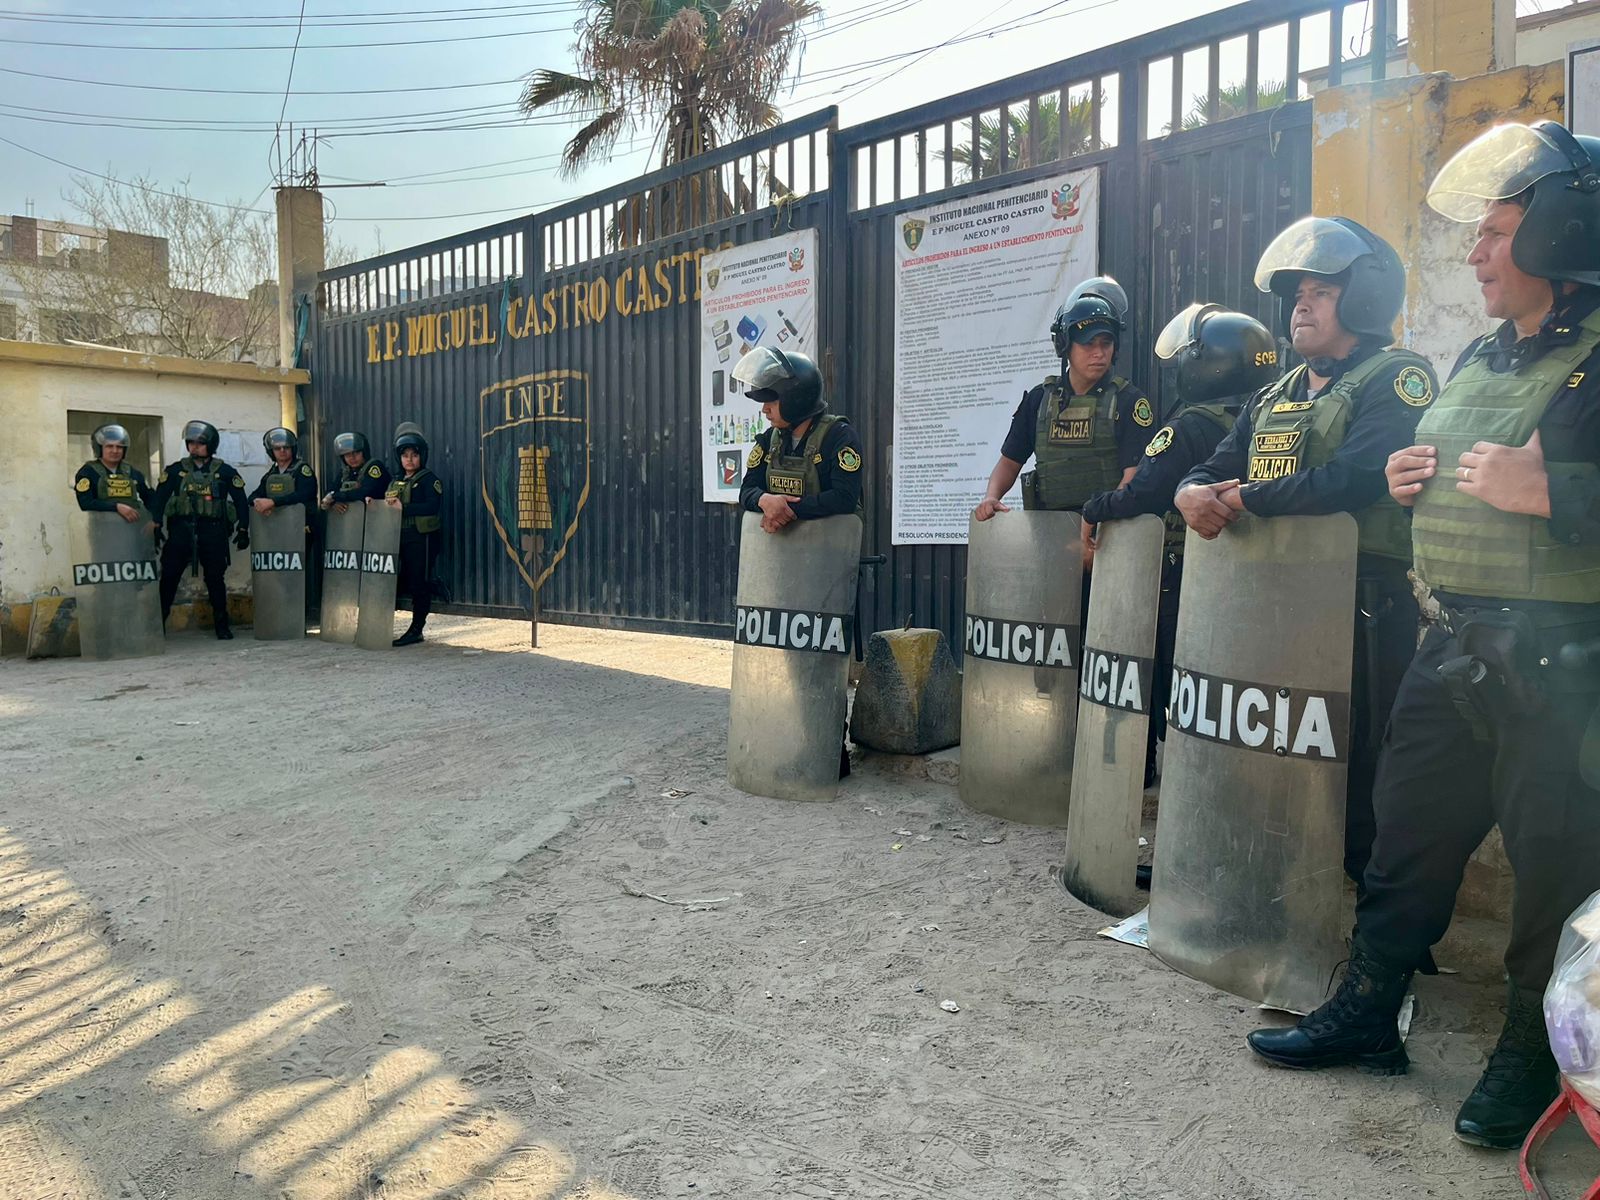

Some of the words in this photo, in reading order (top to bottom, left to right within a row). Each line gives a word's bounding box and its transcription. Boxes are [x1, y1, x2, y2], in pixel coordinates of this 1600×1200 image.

[930, 208, 961, 224] INSTITUTO
[963, 202, 995, 216] NACIONAL
[997, 189, 1048, 209] PENITENCIARIO
[944, 220, 975, 233] MIGUEL
[976, 213, 1009, 226] CASTRO
[1010, 205, 1045, 219] CASTRO
[963, 229, 989, 241] ANEXO
[1001, 225, 1010, 234] 09
[968, 243, 989, 253] INGRESO
[1001, 232, 1045, 248] ESTABLECIMIENTO
[1045, 224, 1083, 239] PENITENCIARIO
[767, 261, 786, 271] CASTRO
[406, 303, 496, 357] MIGUEL
[506, 276, 610, 340] CASTRO
[615, 242, 735, 317] CAST
[731, 289, 761, 301] PROHIBIDOS
[762, 285, 777, 295] PARA
[785, 278, 810, 289] INGRESO
[767, 287, 808, 302] PENITENCIARIO
[505, 381, 565, 421] INPE
[1051, 420, 1090, 439] POLICIA
[1251, 458, 1292, 479] POLICIA
[75, 562, 156, 585] POLICIA
[736, 608, 846, 653] POLICIA
[965, 616, 1073, 667] POLICIA
[1168, 668, 1337, 758] POLICIA
